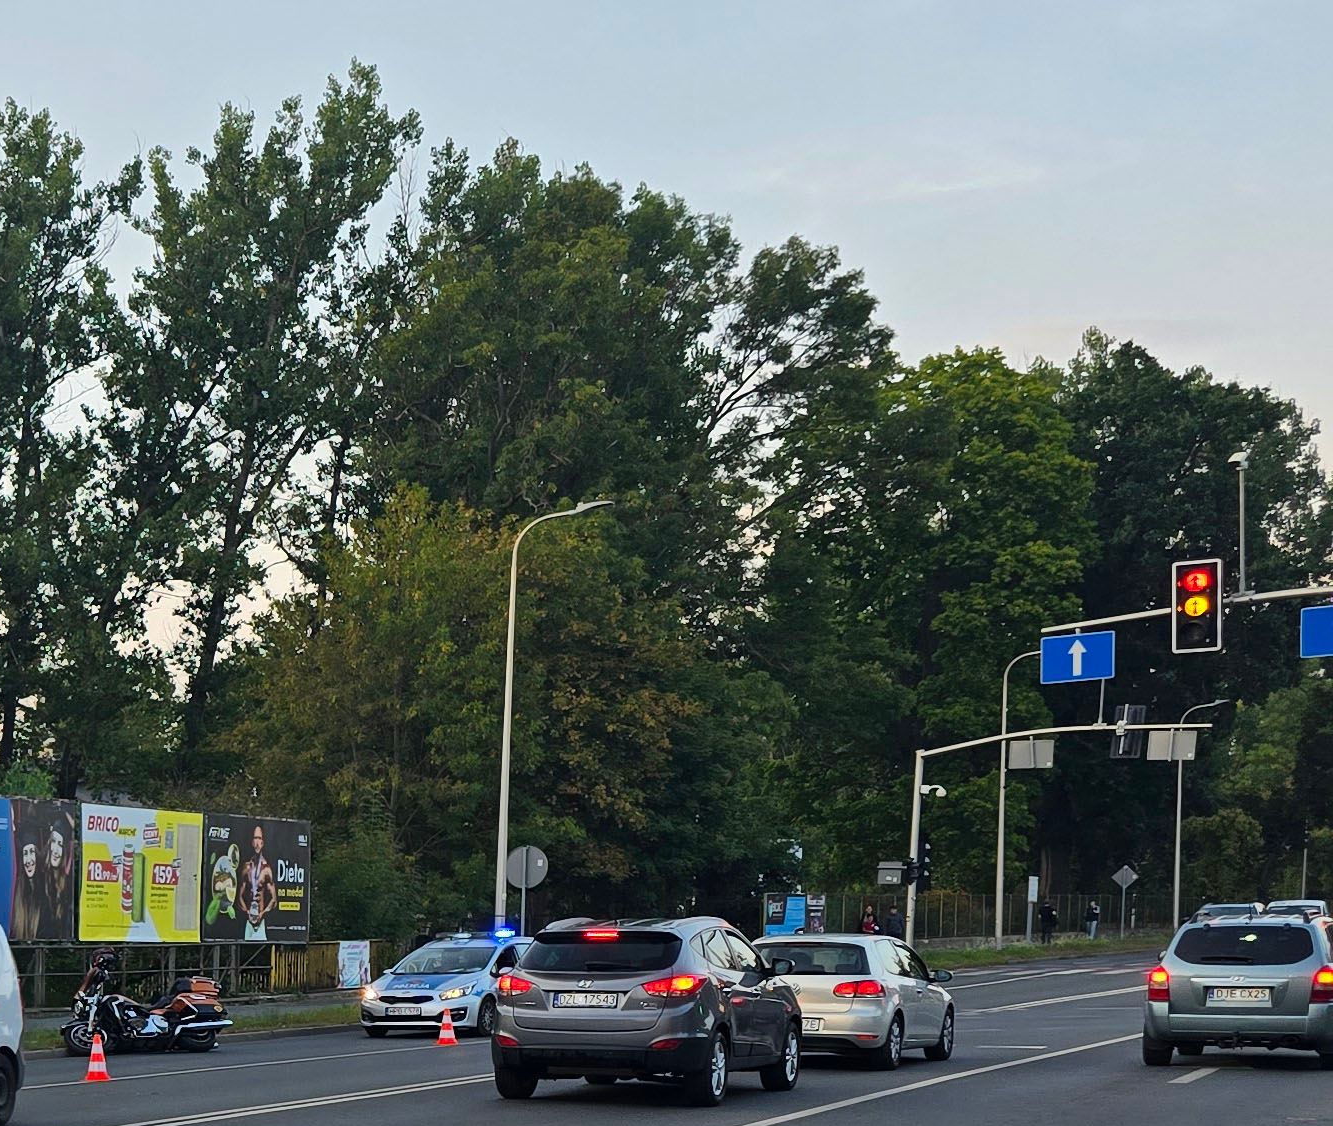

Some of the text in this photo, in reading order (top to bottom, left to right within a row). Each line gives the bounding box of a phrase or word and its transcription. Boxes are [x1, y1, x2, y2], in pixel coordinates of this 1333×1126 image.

[87, 815, 119, 832] BRICO
[277, 860, 304, 882] Dieta
[287, 886, 304, 897] medal
[560, 994, 615, 1004] DZL 17543
[1217, 990, 1266, 998] DJE CX25
